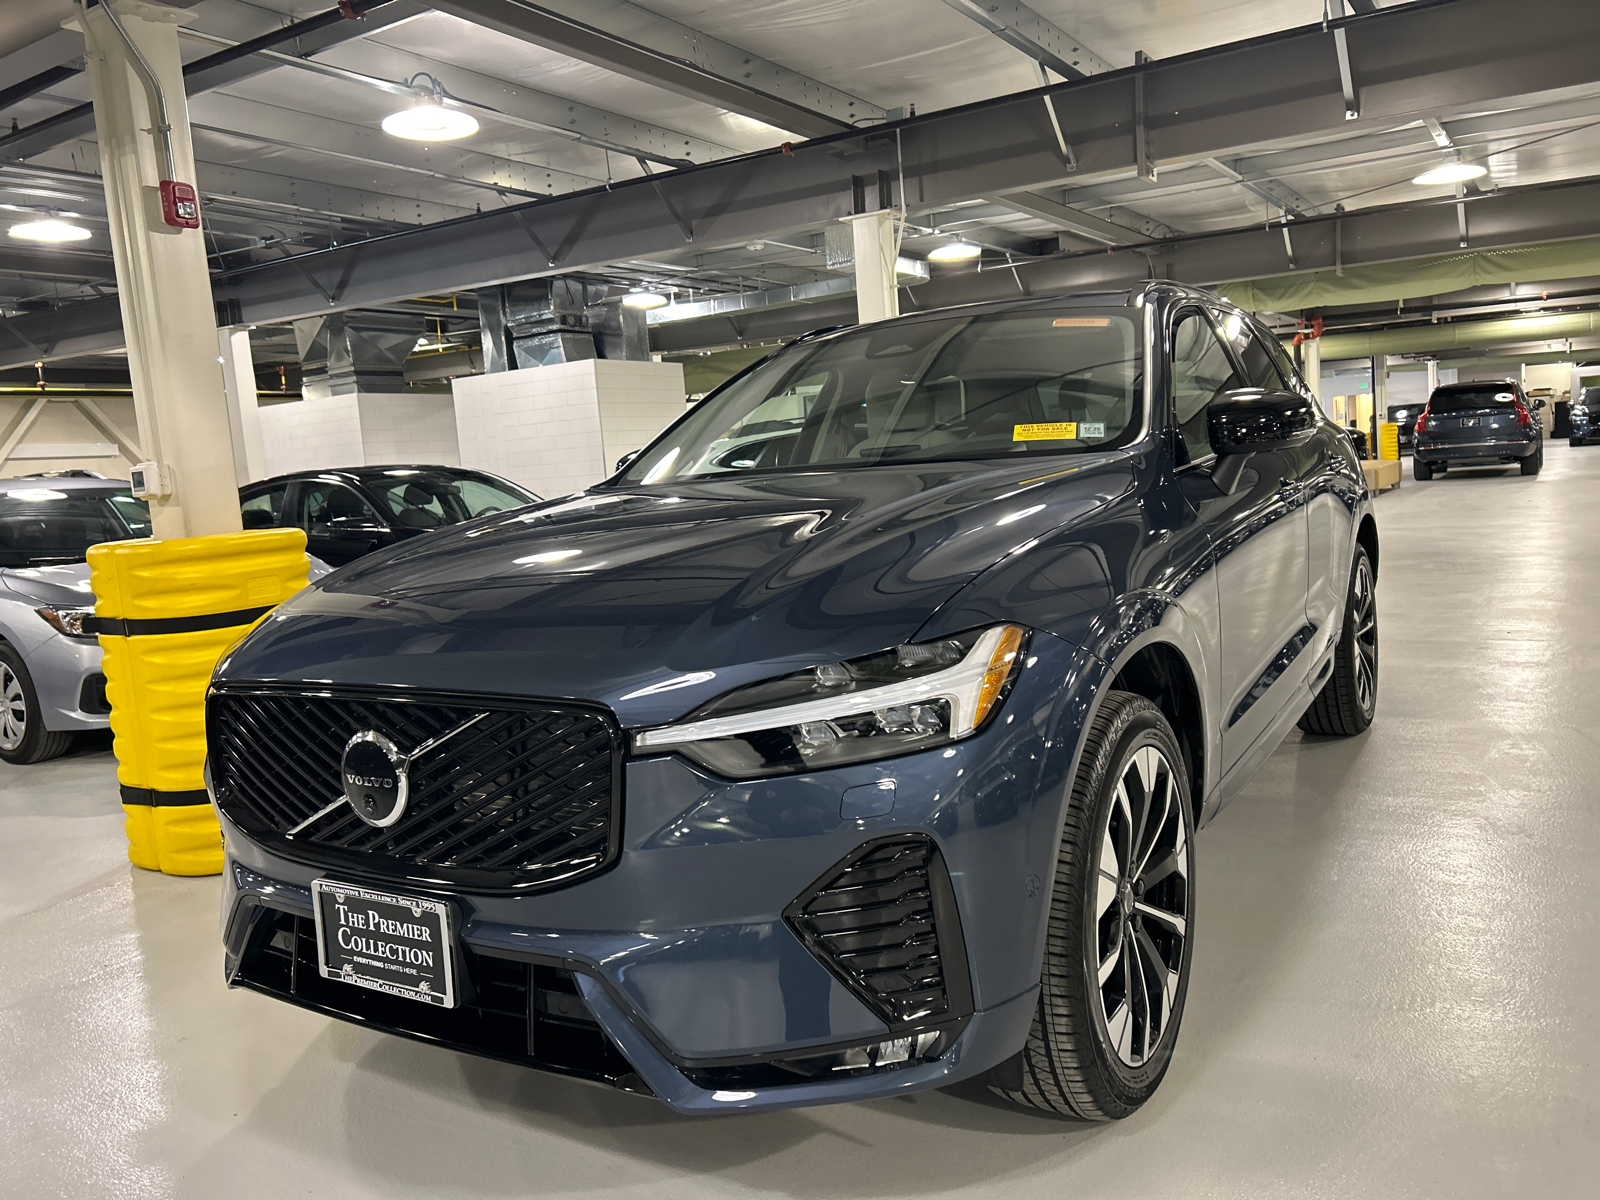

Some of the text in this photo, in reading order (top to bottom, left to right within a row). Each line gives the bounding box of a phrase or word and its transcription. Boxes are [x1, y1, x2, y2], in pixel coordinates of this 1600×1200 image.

[346, 773, 393, 788] VOLVO
[418, 901, 436, 912] 1995
[335, 903, 432, 942] THE PREMIER
[338, 926, 433, 967] COLLECTION
[353, 955, 384, 969] EVERYTHING
[384, 962, 403, 973] STARTS
